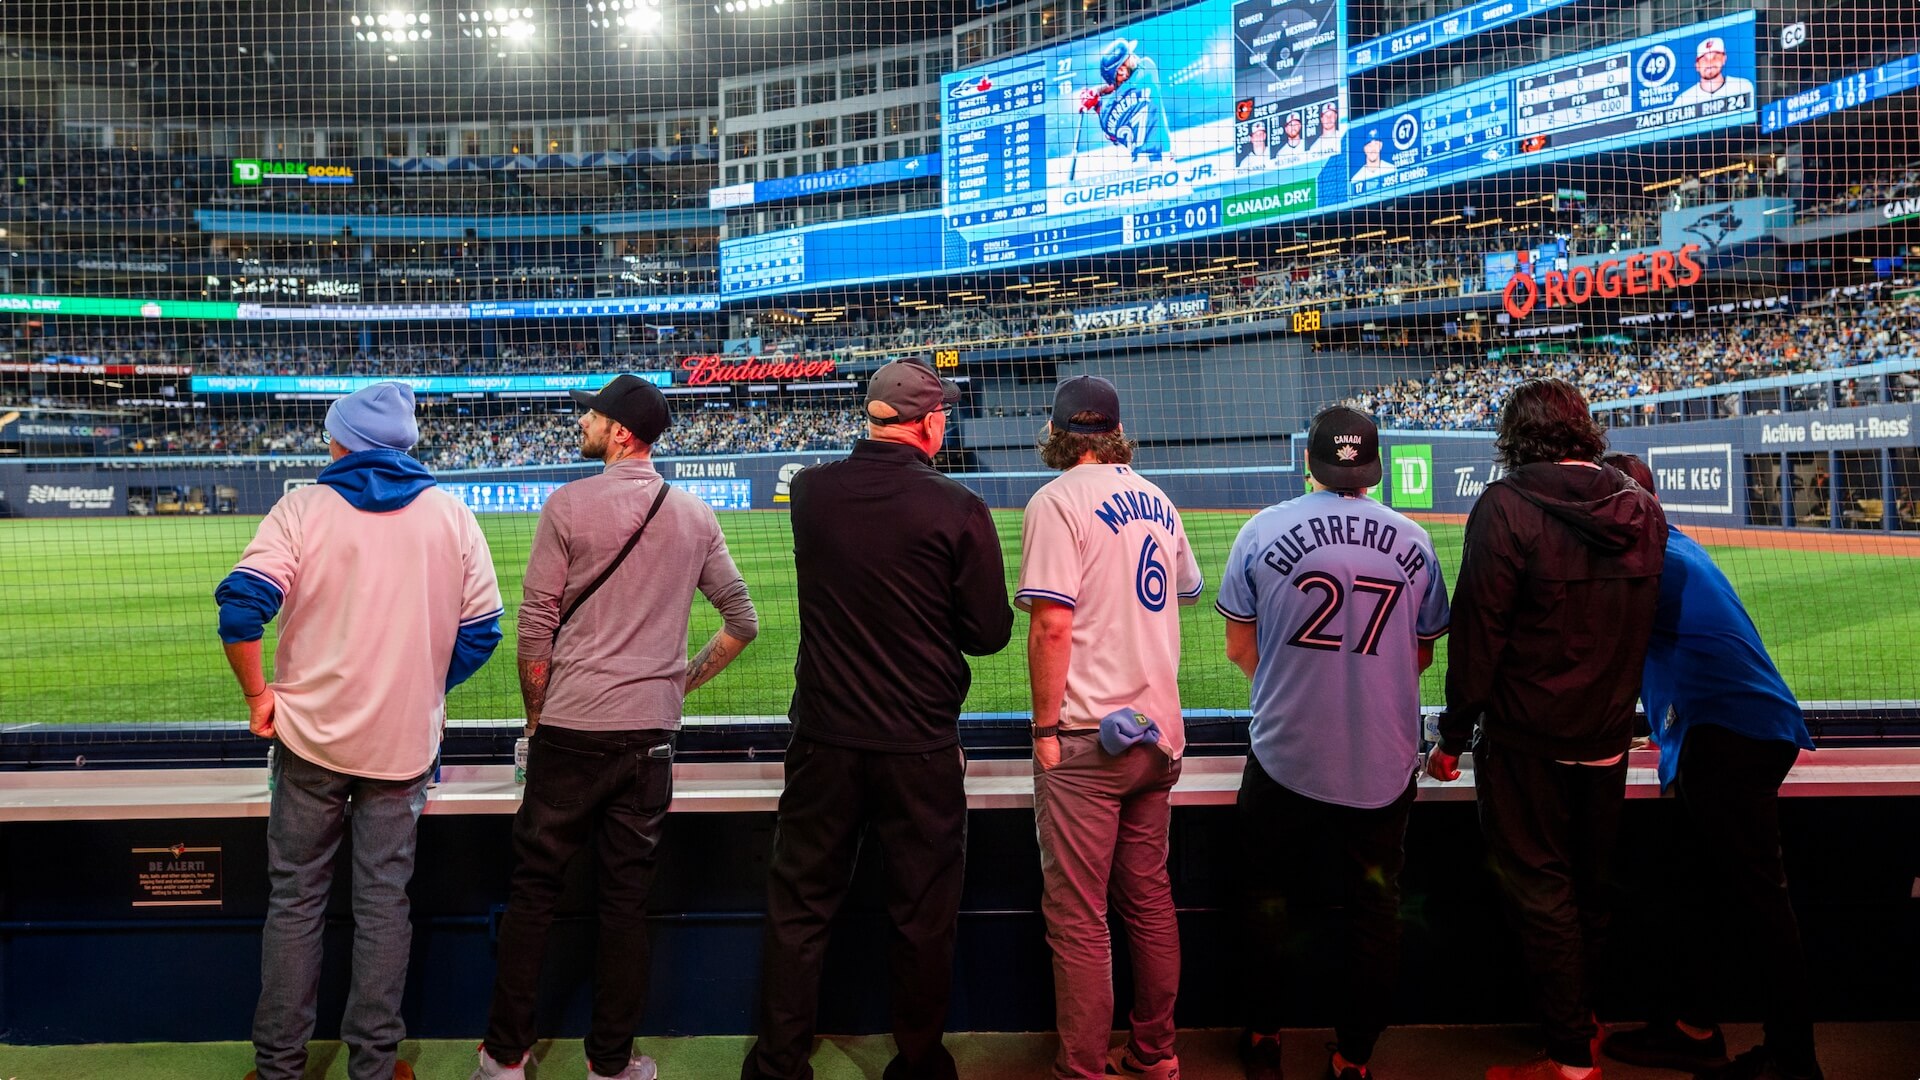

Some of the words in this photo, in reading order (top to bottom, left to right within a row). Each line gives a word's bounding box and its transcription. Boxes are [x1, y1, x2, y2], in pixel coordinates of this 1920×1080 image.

[1391, 35, 1412, 53] 81.5
[1785, 27, 1802, 44] CC
[1057, 58, 1072, 74] 27
[1606, 59, 1617, 70] ER
[1646, 56, 1666, 75] 49
[1608, 74, 1614, 84] 0
[1003, 89, 1012, 99] SS
[1603, 87, 1620, 99] ERA
[1787, 89, 1820, 110] ORIOLES
[1836, 80, 1842, 94] 1
[1848, 77, 1853, 91] 1
[1858, 73, 1866, 87] 3
[1878, 67, 1884, 81] 1
[1306, 105, 1319, 119] 32
[1601, 100, 1621, 112] 0.00
[1636, 112, 1664, 129] ZACH
[1666, 105, 1696, 122] EFLIN
[1702, 100, 1724, 115] RHP
[1727, 96, 1745, 110] 24
[1787, 108, 1808, 123] BLUE
[1809, 101, 1829, 117] JAYS
[1835, 95, 1844, 109] 0
[1847, 92, 1855, 106] 0
[1858, 88, 1866, 102] 0
[1423, 119, 1436, 131] 4.0
[1446, 114, 1451, 125] 7
[1466, 108, 1472, 119] 6
[1490, 101, 1496, 112] 6
[1768, 111, 1775, 122] 4
[1237, 123, 1248, 137] 35
[1398, 123, 1411, 139] 67
[1426, 145, 1432, 156] 2
[1444, 140, 1450, 151] 3
[1464, 133, 1473, 145] 14
[235, 163, 260, 180] TD
[263, 162, 307, 174] PARK
[308, 166, 354, 177] SOCIAL
[798, 173, 848, 192] TORONTO
[1063, 171, 1178, 206] GUERRERO
[1184, 164, 1217, 182] JR.
[1355, 183, 1363, 193] 17
[992, 210, 1008, 220] .000
[1011, 207, 1026, 218] .000
[1030, 204, 1045, 214] .000
[1226, 194, 1282, 217] CANADA
[983, 239, 1010, 251] ORIOLES
[1052, 230, 1058, 240] 3
[1143, 214, 1149, 224] 0
[1169, 209, 1175, 219] 4
[1033, 246, 1040, 256] 0
[1052, 243, 1058, 253] 0
[1135, 230, 1141, 240] 0
[1144, 228, 1150, 239] 0
[1155, 226, 1161, 237] 0
[1169, 224, 1176, 234] 3
[77, 260, 118, 271] CARLOS
[291, 267, 321, 276] CHEEK
[512, 267, 529, 276] JOE
[531, 266, 561, 275] CARTER
[631, 262, 661, 272] GEORGE
[663, 260, 681, 269] BELL
[1545, 244, 1702, 308] ROGERS
[1170, 299, 1207, 314] FLIGHT
[1293, 310, 1321, 333] 0:28
[936, 350, 959, 368] 0:28
[682, 354, 836, 385] Budweiser
[208, 377, 259, 390] wegovy
[299, 378, 348, 391] wegovy
[467, 376, 512, 390] wegovy
[543, 375, 588, 389] wegovy
[19, 425, 70, 435] RETHINK
[1761, 424, 1805, 444] Active
[1333, 434, 1362, 445] CANADA
[675, 462, 705, 479] PIZZA
[708, 461, 736, 478] NOVA
[1395, 457, 1428, 495] TD
[1454, 466, 1484, 497] Tim
[1657, 468, 1686, 490] THE
[1691, 468, 1721, 491] KEG
[48, 486, 115, 502] National
[1095, 490, 1176, 536] MANOAH
[1264, 515, 1398, 577] GUERRERO
[1396, 543, 1426, 586] JR.
[1136, 534, 1168, 613] 6
[1286, 570, 1405, 657] 27
[149, 861, 163, 872] BE
[166, 861, 205, 872] ALERT!
